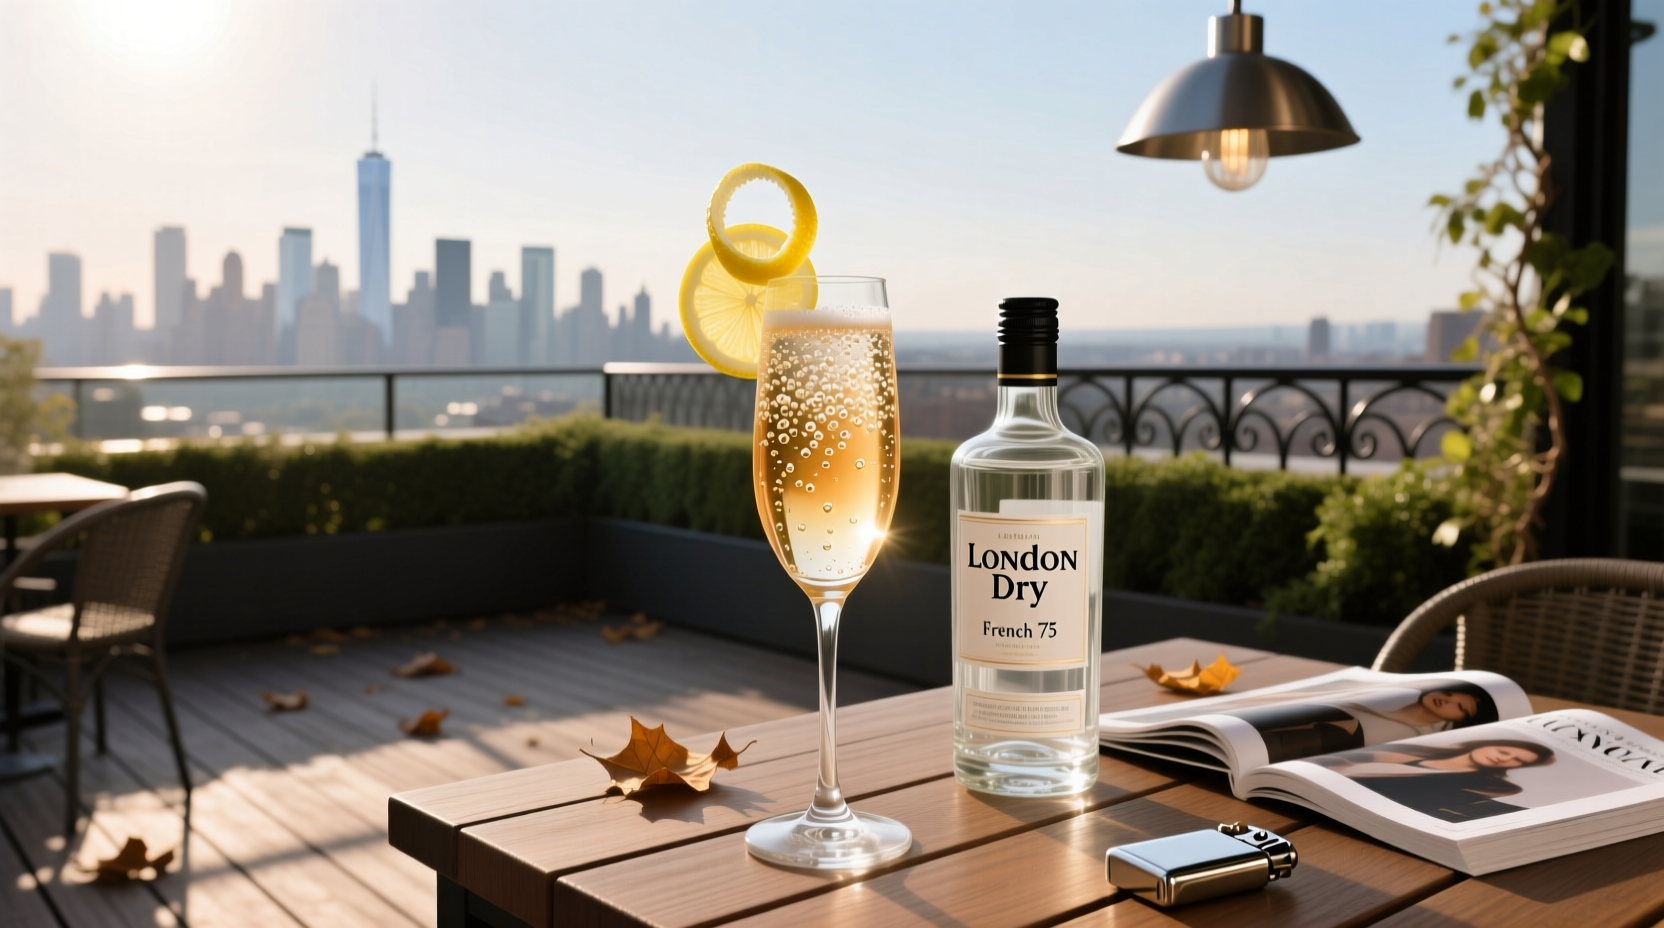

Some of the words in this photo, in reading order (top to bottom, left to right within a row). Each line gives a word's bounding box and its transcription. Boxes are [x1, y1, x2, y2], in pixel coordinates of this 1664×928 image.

[991, 573, 1048, 608] Dry
[983, 620, 1033, 639] French
[1038, 621, 1057, 639] 75
